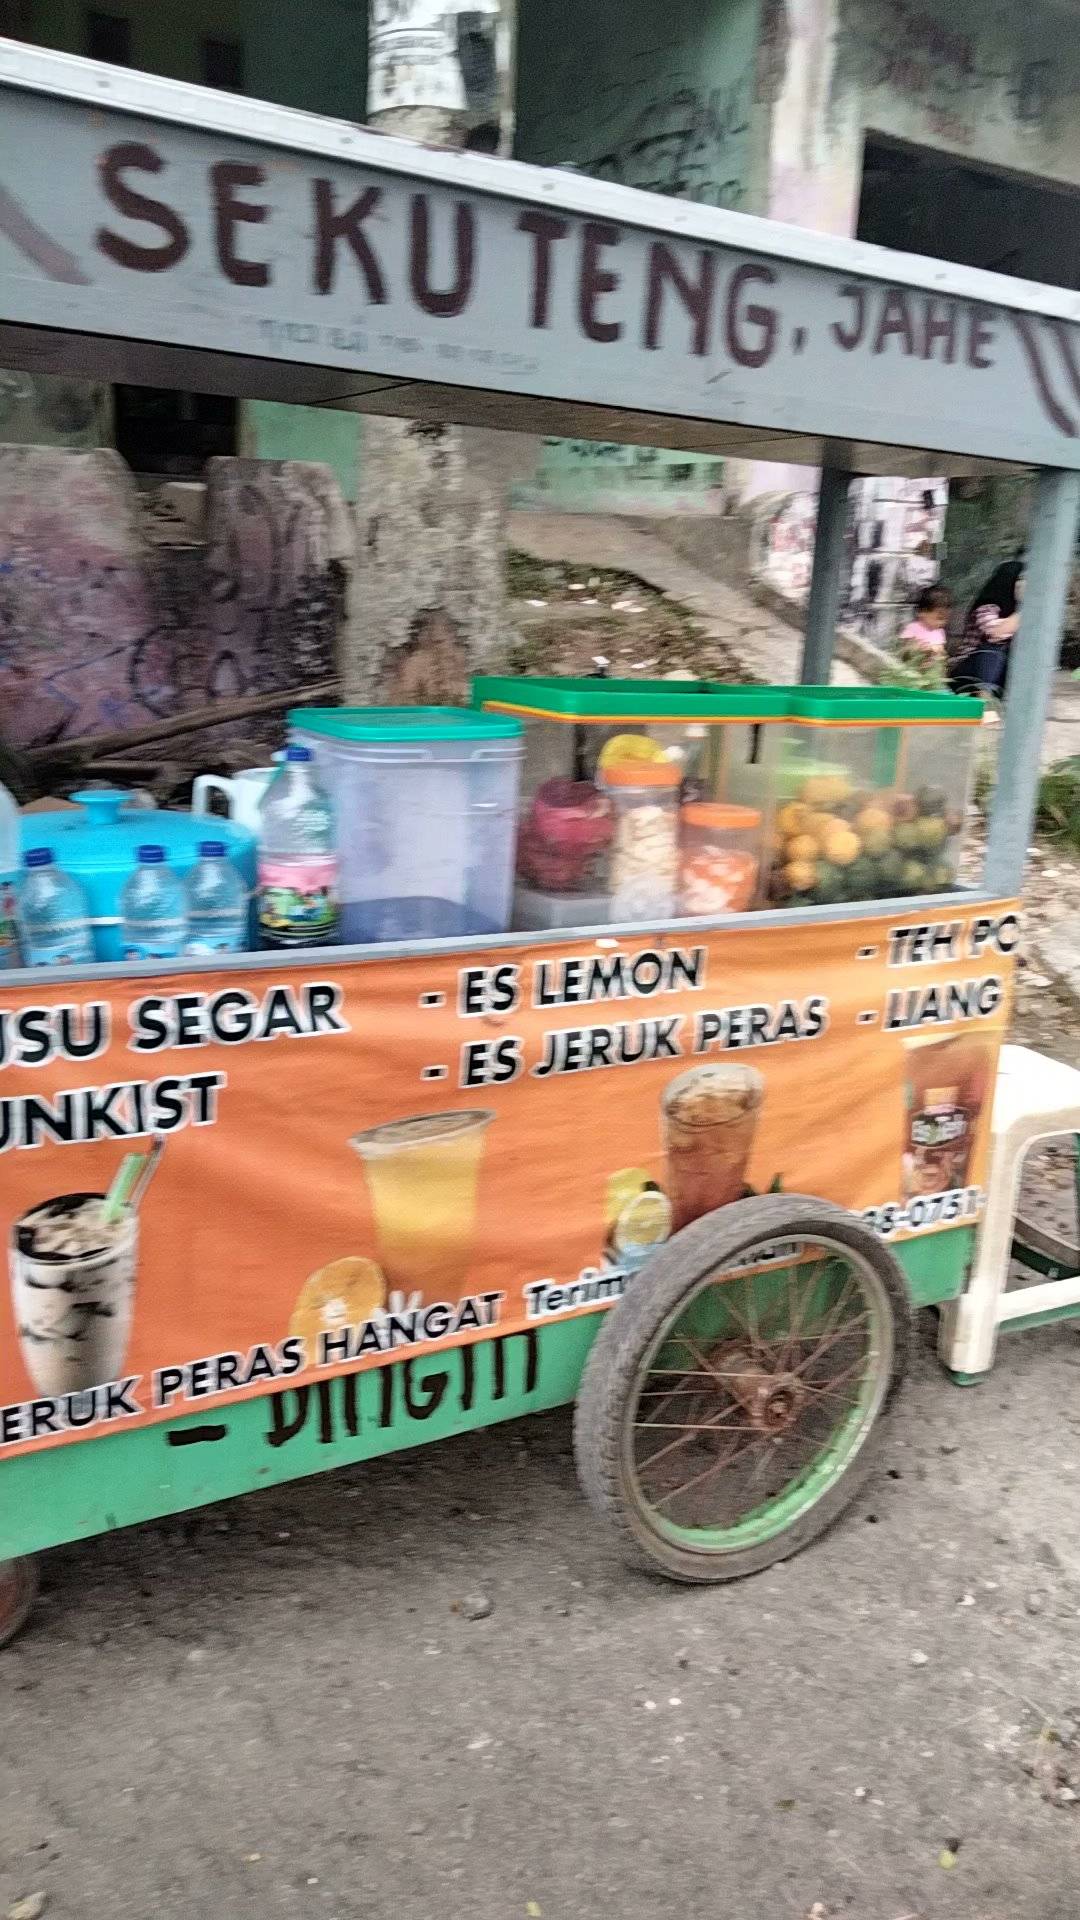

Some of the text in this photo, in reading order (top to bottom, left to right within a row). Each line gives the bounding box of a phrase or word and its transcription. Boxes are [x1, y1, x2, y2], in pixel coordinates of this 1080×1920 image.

[827, 284, 996, 369] JAHE
[463, 965, 518, 1014] ES
[536, 948, 706, 1007] LEMON
[887, 921, 964, 967] TEH
[0, 984, 345, 1066] SU SEGAR
[464, 1038, 520, 1087] ES
[536, 1017, 684, 1077] JERUK
[698, 997, 826, 1052] PERAS
[884, 977, 1001, 1031] LIANG
[0, 1073, 222, 1149] NKIST
[528, 1270, 634, 1316] Terim
[158, 1336, 304, 1405] PERAS
[320, 1291, 502, 1360] HANGAT
